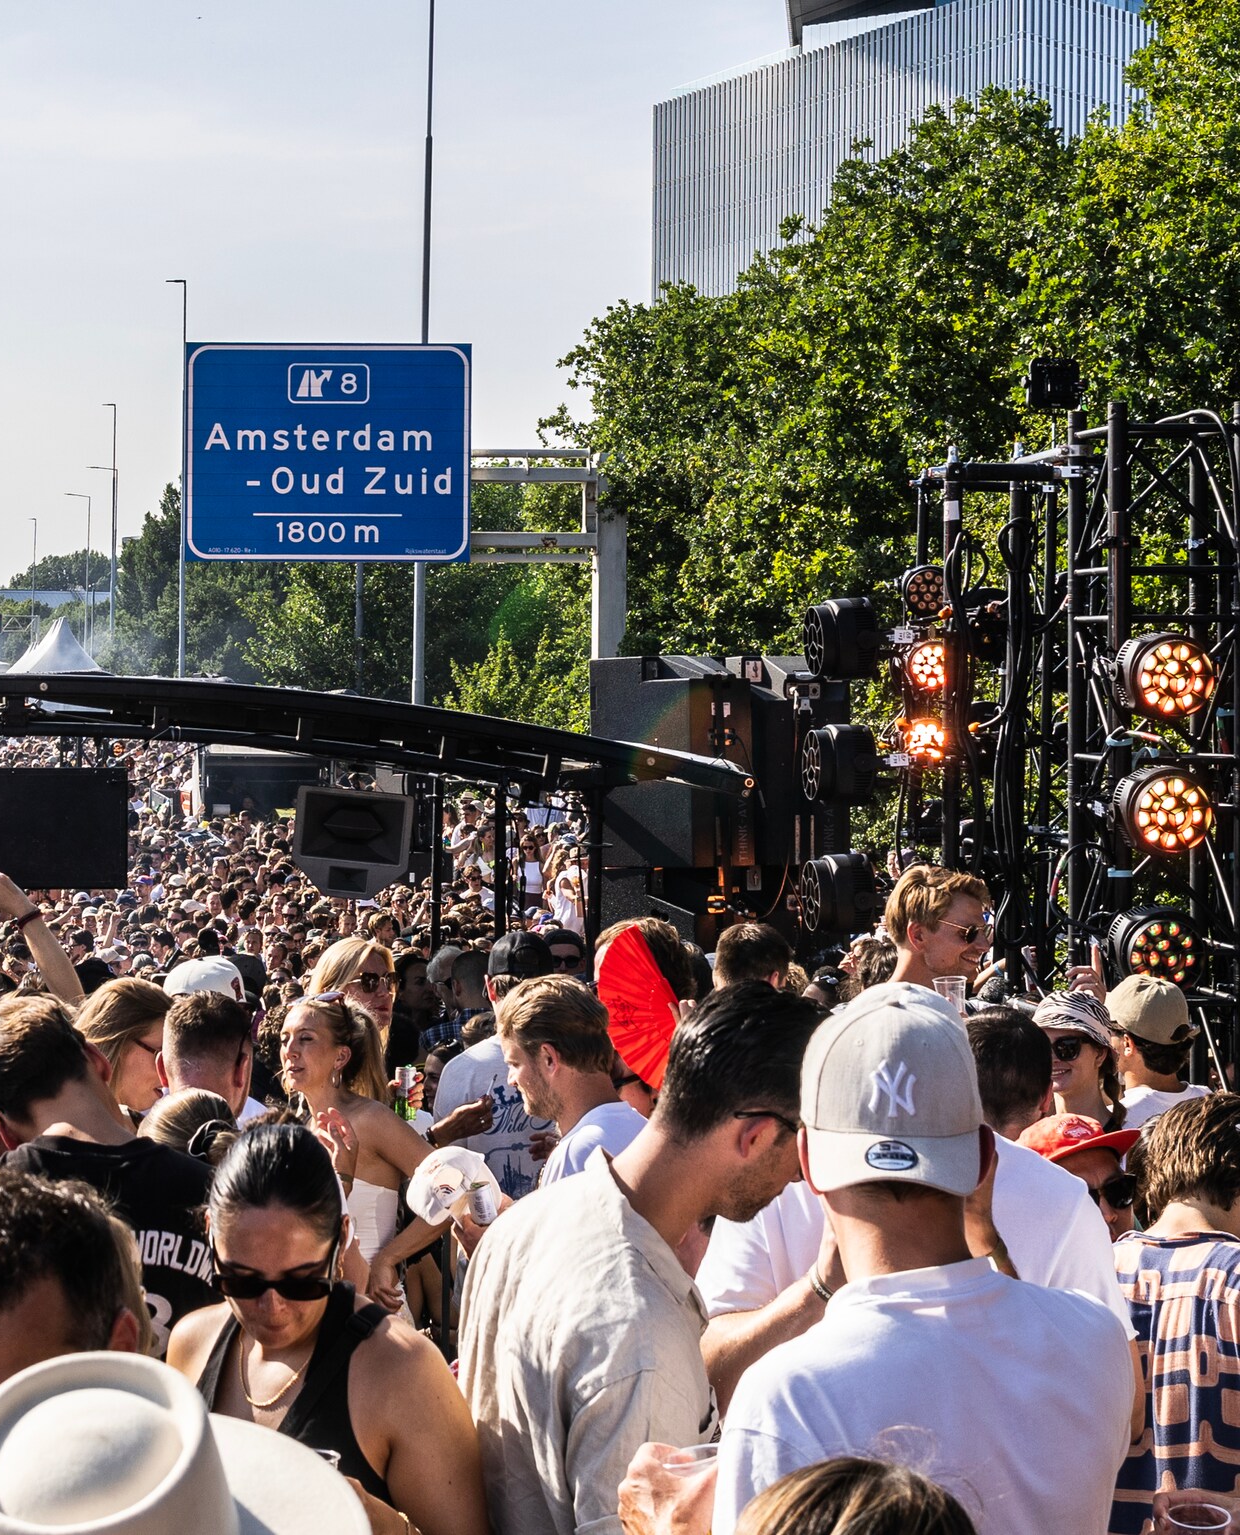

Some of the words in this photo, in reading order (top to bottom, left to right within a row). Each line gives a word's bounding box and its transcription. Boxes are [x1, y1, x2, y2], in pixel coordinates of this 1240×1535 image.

[340, 372, 358, 395] 8
[204, 422, 433, 452] Amsterdam
[246, 466, 344, 495] -Oud
[364, 466, 452, 495] Zuid
[276, 521, 346, 543] 1800
[354, 523, 380, 543] m
[738, 798, 749, 863] THINK-AV
[867, 1058, 917, 1118] NY
